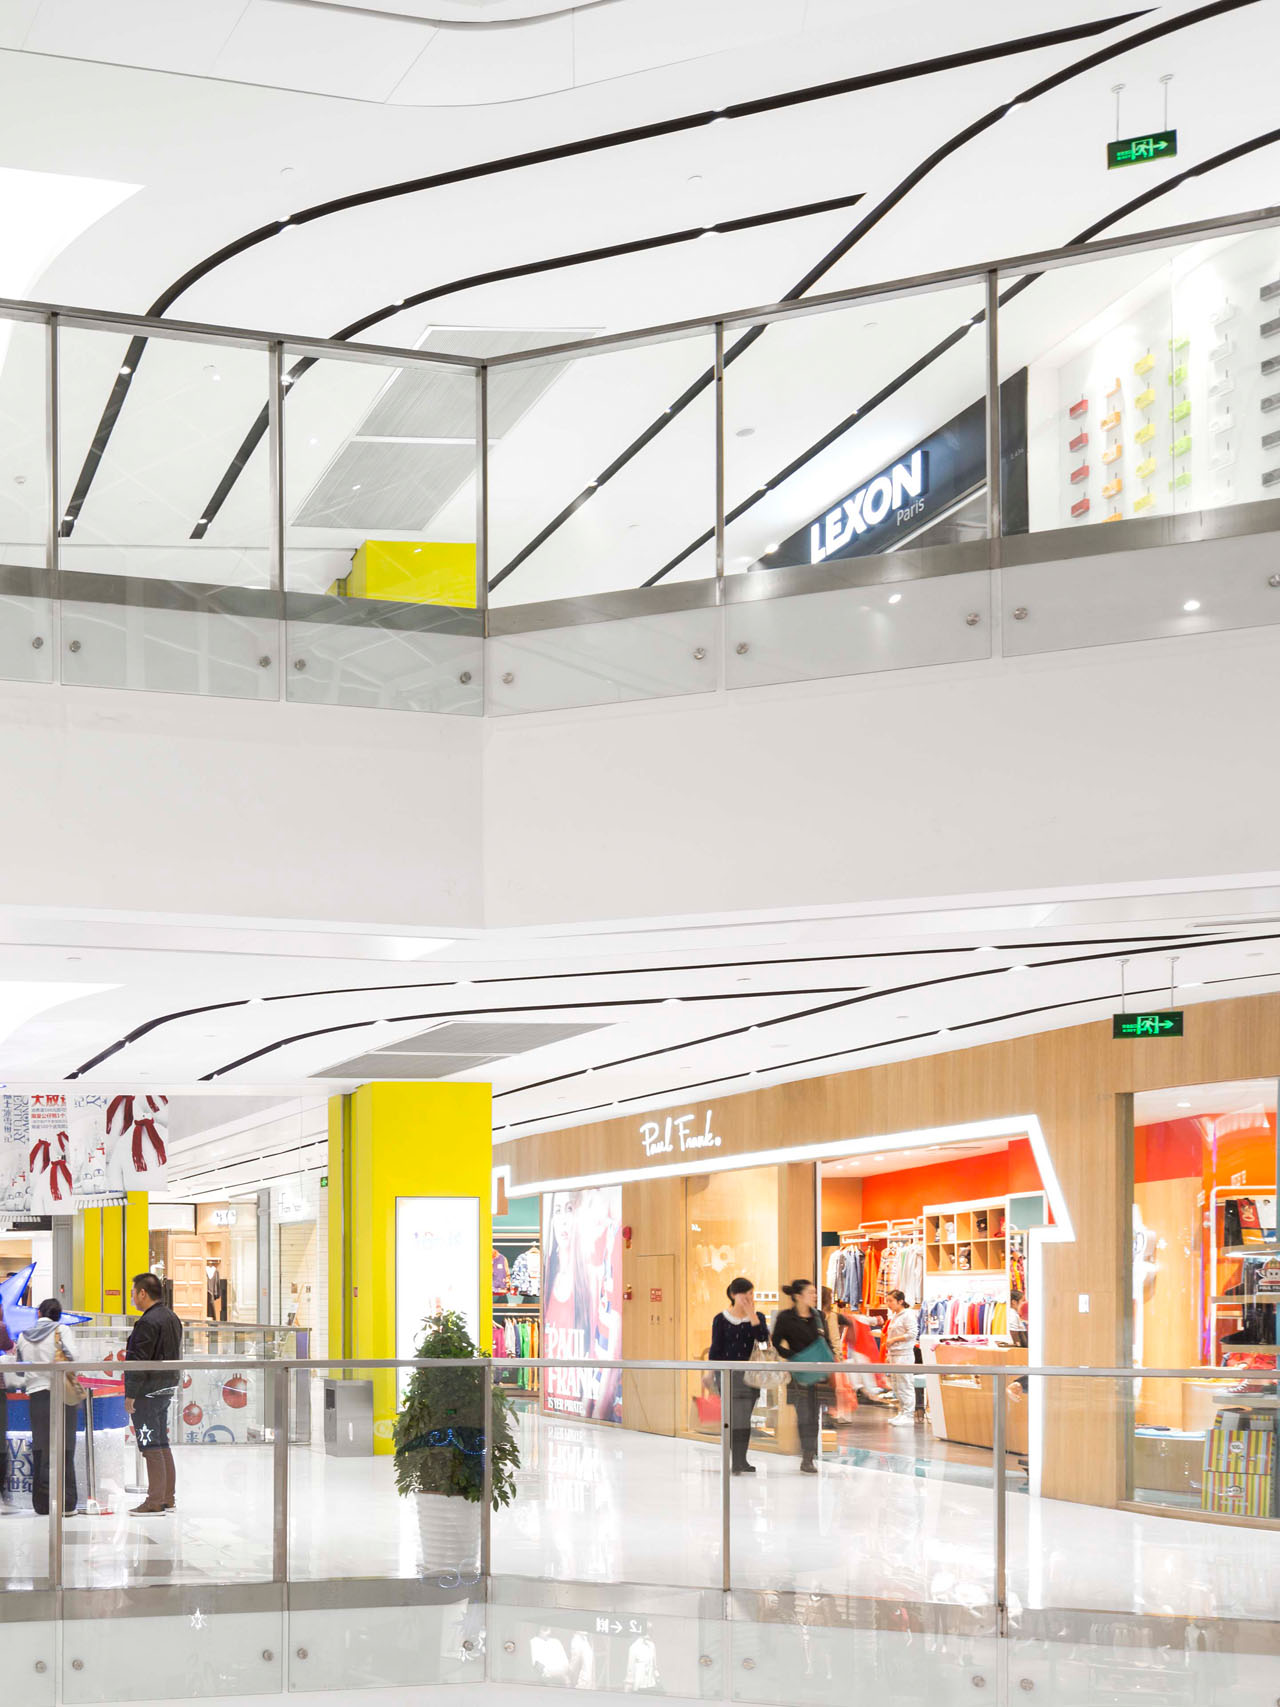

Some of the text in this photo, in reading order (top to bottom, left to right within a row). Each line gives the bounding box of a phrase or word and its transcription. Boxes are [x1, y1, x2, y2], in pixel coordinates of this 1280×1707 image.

[811, 450, 921, 565] LEXON
[897, 498, 925, 526] Paris
[13, 1095, 25, 1144] ENTURY
[639, 1110, 714, 1156] Paul Frank
[548, 1327, 588, 1360] PAUL
[548, 1366, 600, 1400] FRANK
